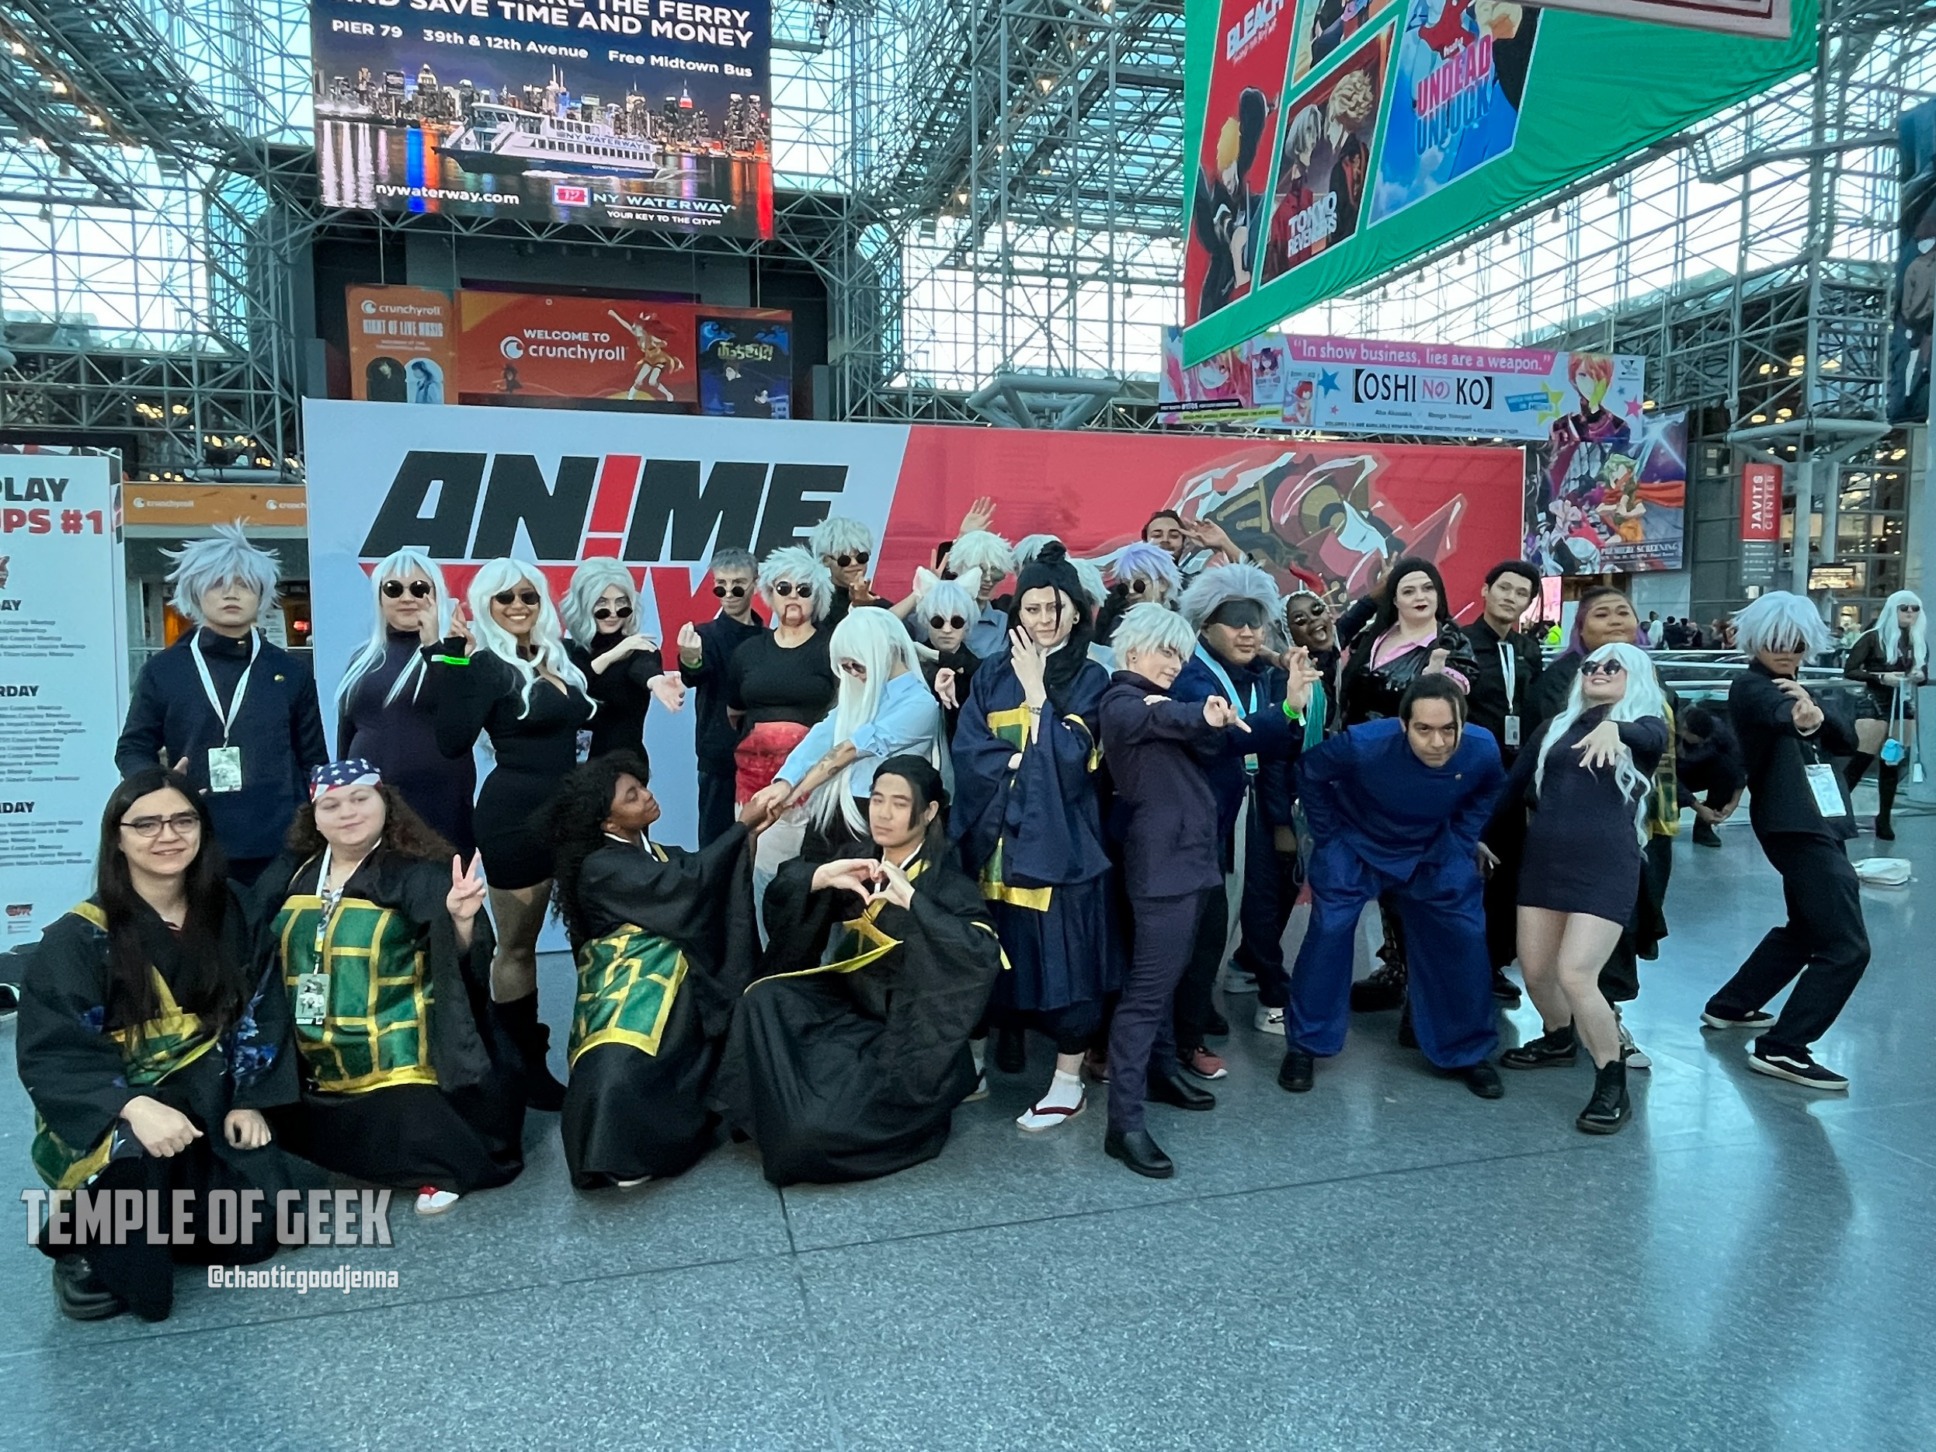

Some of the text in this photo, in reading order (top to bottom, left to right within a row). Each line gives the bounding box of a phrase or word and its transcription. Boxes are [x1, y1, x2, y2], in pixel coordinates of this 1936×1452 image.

[409, 0, 753, 48] SAVE TIME AND MONEY
[658, 0, 751, 28] FERRY
[332, 19, 403, 38] PIER 79
[423, 29, 588, 59] 39th & 12th Avenue
[608, 50, 753, 78] Free Midtown Bus
[1416, 34, 1493, 117] UNDEAD
[566, 132, 644, 150] NY WATERWAY
[375, 183, 520, 205] nywaterway.com
[593, 193, 623, 204] NY
[626, 196, 731, 214] WATERWAY
[607, 210, 634, 220] YOUR
[635, 212, 654, 222] KEY
[657, 214, 670, 223] TO
[672, 216, 690, 224] THE
[1288, 191, 1338, 240] TOKYO
[379, 304, 441, 316] crunchyroll
[523, 328, 611, 343] WELCOME TO
[528, 343, 625, 364] crunchyroll
[1319, 344, 1357, 360] show
[1360, 345, 1421, 365] business,
[1425, 347, 1448, 365] lies
[1451, 355, 1473, 367] are
[1476, 356, 1484, 368] a
[1421, 378, 1450, 400] NO
[0, 477, 69, 502] LAY
[1751, 475, 1764, 530] JAVITS
[1765, 474, 1776, 530] CENTER
[61, 509, 103, 535] #1
[0, 801, 35, 814] DAY
